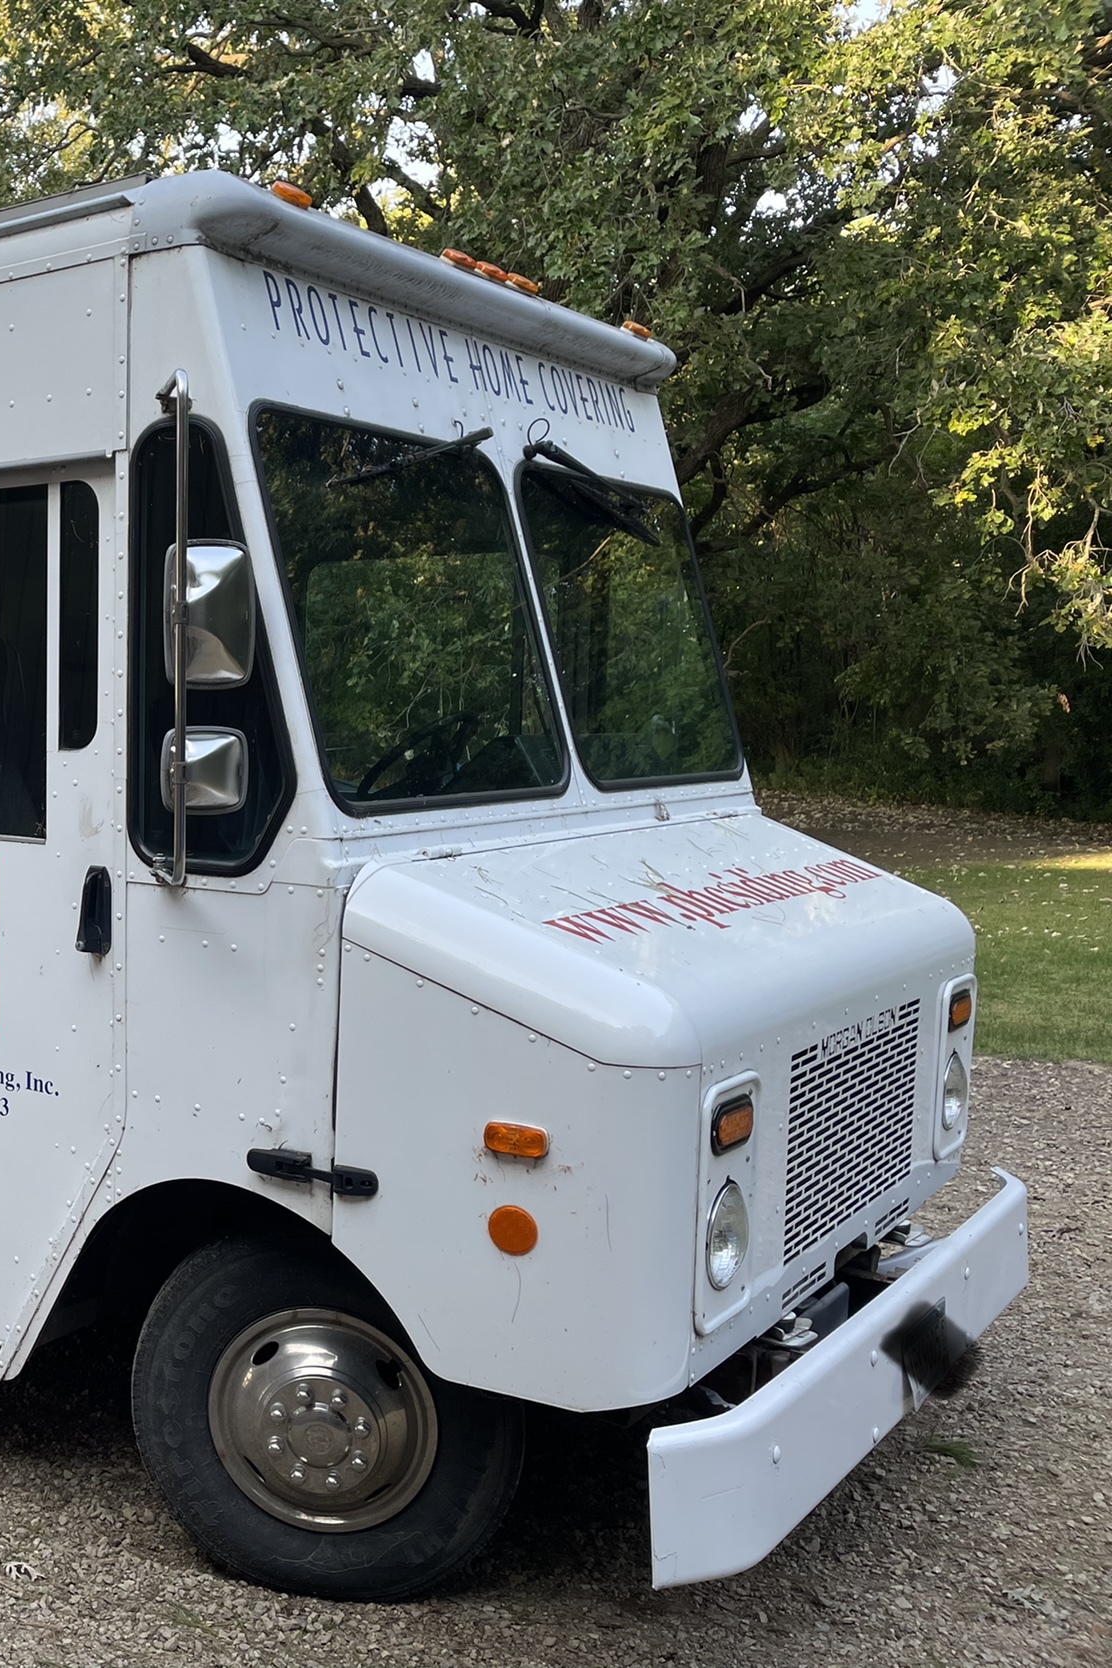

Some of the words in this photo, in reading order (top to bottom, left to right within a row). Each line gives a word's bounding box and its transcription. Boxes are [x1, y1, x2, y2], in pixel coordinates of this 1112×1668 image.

[262, 269, 459, 384] PROTECTIVE
[465, 337, 534, 406] HOME
[538, 361, 636, 434] COVERING
[542, 860, 883, 945] www.phcsiding.com
[820, 1020, 864, 1061] MORGAN
[25, 1071, 60, 1097] Inc.
